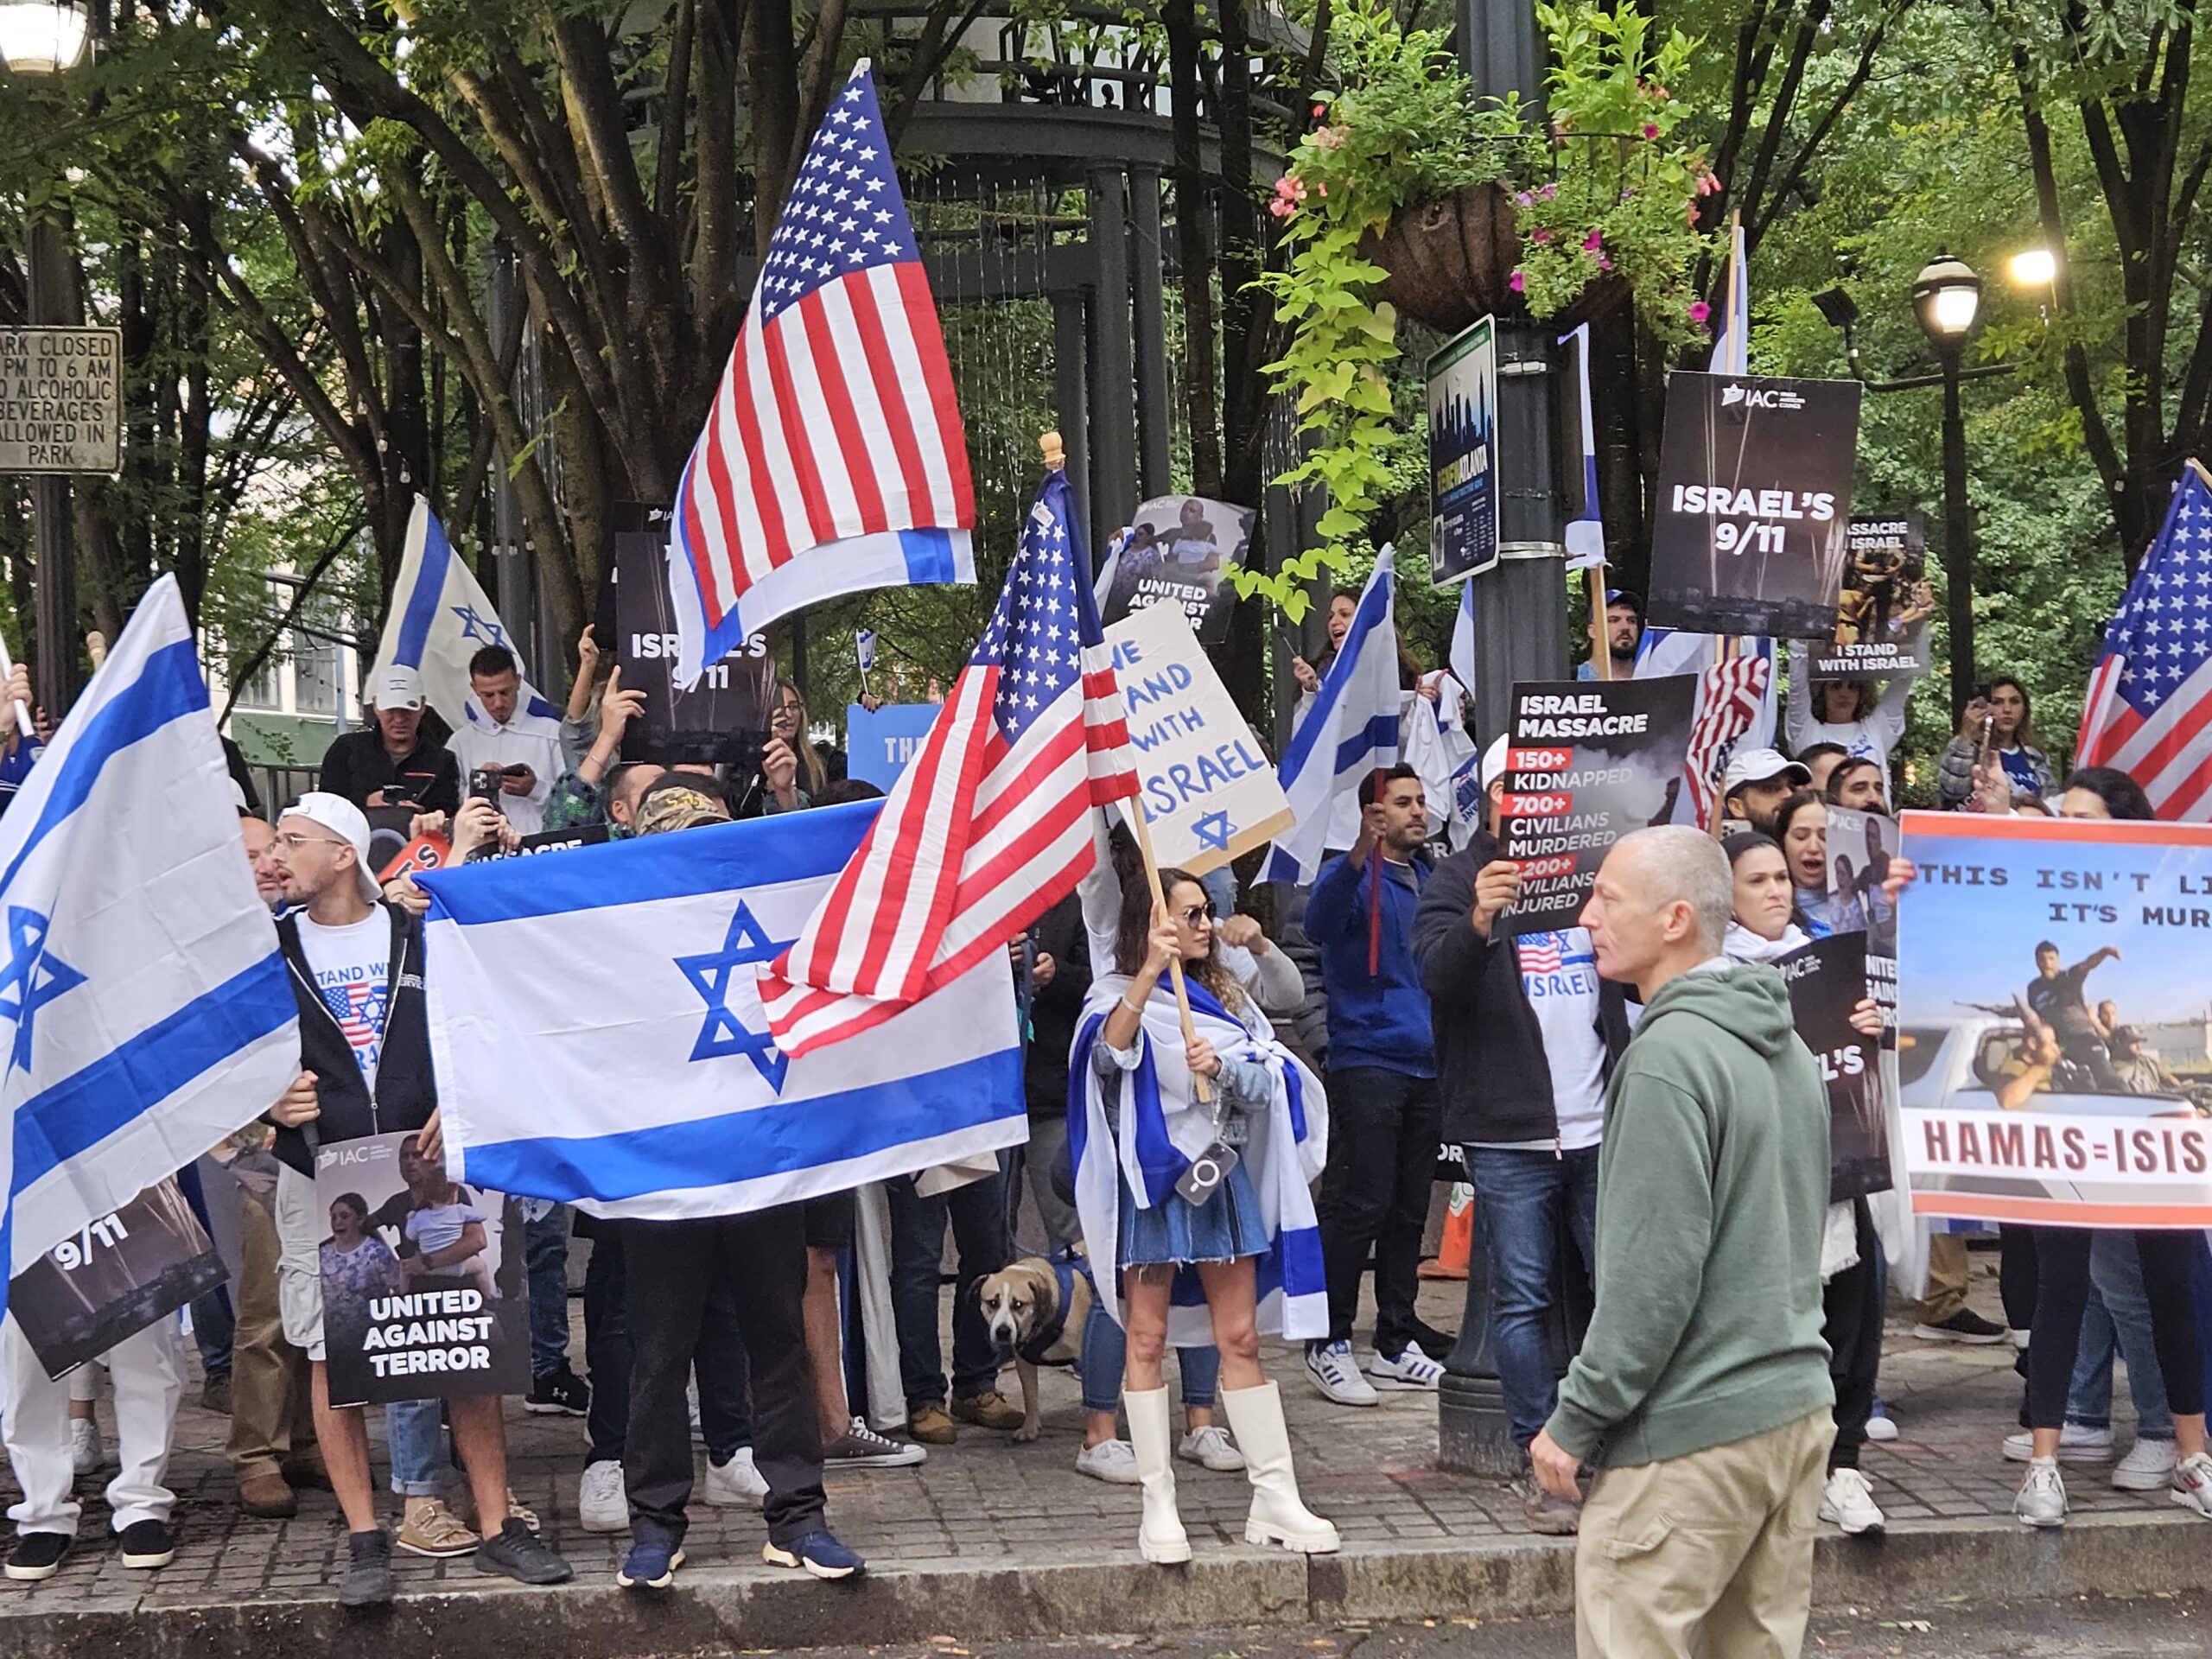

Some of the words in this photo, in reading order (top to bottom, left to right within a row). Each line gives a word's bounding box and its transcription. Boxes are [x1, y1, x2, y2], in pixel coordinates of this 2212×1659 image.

[0, 336, 29, 356] RK
[40, 336, 111, 356] CLOSED
[4, 358, 28, 378] PM
[37, 359, 57, 378] TO
[67, 359, 78, 378] 6
[86, 360, 111, 378] AM
[16, 379, 112, 400] ALCOHOLIC
[1745, 388, 1778, 408] IAC
[87, 424, 105, 443] IN
[29, 445, 74, 464] PARK
[1672, 484, 1835, 521] ISRAEL'S
[1714, 521, 1786, 556] 9/11
[1851, 537, 1904, 549] ISRAEL
[1138, 578, 1207, 601] UNITED
[1837, 645, 1842, 657] I
[1845, 643, 1898, 657] STAND
[1818, 658, 1860, 671] WITH
[1862, 656, 1920, 671] ISRAEL
[1125, 663, 1192, 715] AND
[1520, 695, 1608, 715] ISRAEL
[1128, 706, 1205, 753] WITH
[1518, 714, 1649, 738] MASSACRE
[1516, 751, 1566, 769] 150+
[1514, 767, 1632, 791] KIDNAPPED
[1512, 796, 1567, 814] 700+
[1510, 811, 1610, 836] CIVILIANS
[1509, 830, 1617, 857] MURDERED
[1516, 871, 1596, 899] IVILIANS
[1918, 864, 2009, 886] THIS
[2037, 868, 2150, 893] ISN'T
[2179, 874, 2212, 895] LI
[2049, 903, 2119, 924] IT'S
[2142, 906, 2211, 929] MUR
[316, 966, 364, 986] TAND
[340, 1146, 368, 1166] IAC
[54, 1212, 129, 1271] 9/11
[369, 1288, 483, 1320] UNITED
[363, 1316, 493, 1351] AGAINST
[369, 1345, 491, 1377] TERROR
